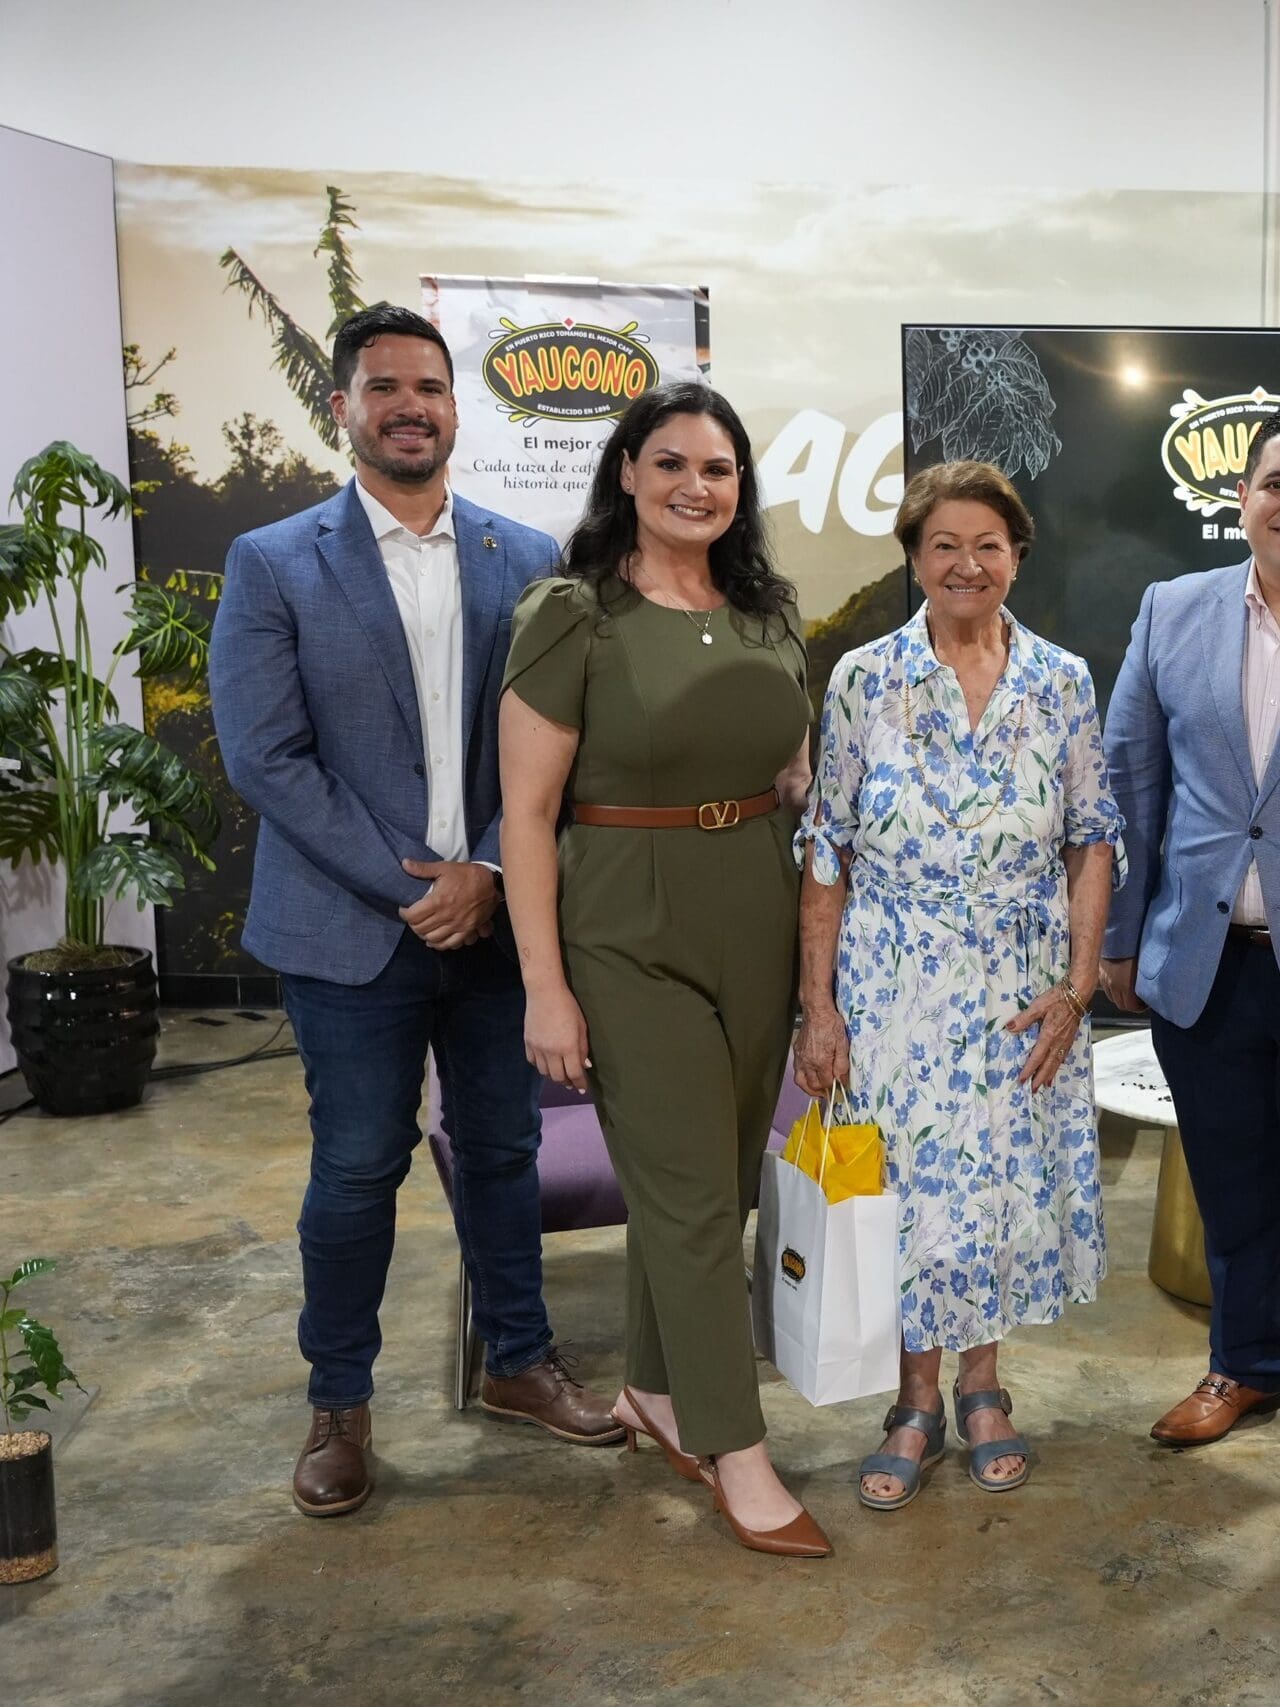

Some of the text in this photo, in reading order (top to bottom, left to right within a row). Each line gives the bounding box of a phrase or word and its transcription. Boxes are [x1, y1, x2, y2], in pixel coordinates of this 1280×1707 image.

[505, 330, 634, 355] EN PUERTO RICO TOMAMOS EL MEJOR CAFÉ
[493, 345, 647, 400] YAUCONO
[537, 403, 611, 416] ESTABLECIDO EN 1896
[523, 437, 538, 449] El
[544, 437, 592, 452] mejor
[473, 459, 512, 473] Cada
[516, 461, 547, 474] taza
[550, 460, 567, 473] de
[503, 476, 588, 492] historia que
[1202, 523, 1219, 540] El
